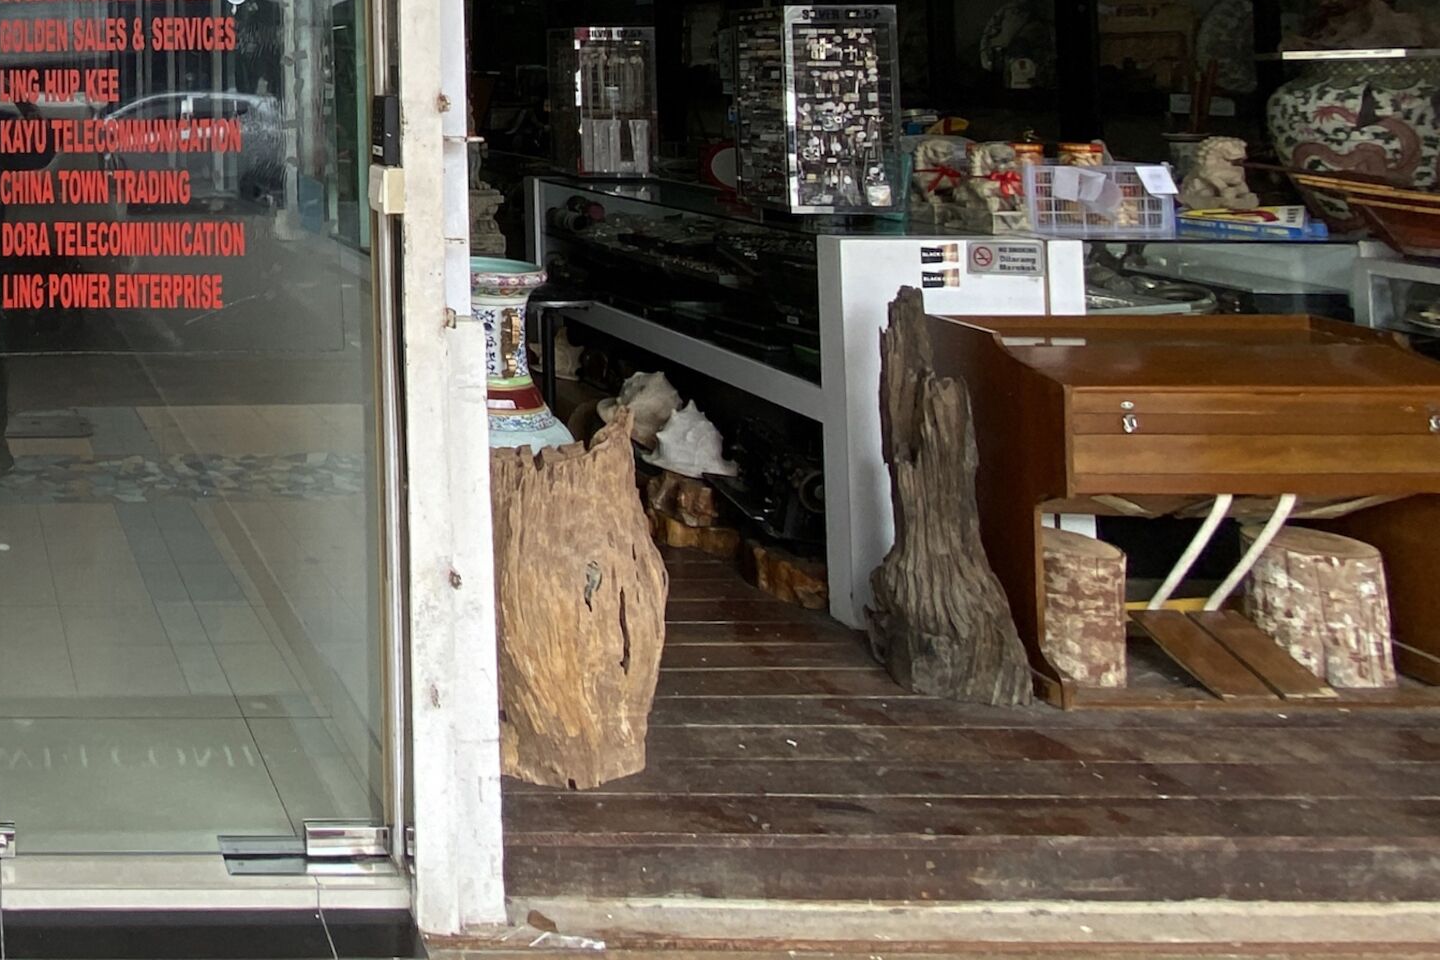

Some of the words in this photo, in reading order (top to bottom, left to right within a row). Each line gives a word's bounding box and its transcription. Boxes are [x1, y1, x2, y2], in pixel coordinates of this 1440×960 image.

[73, 18, 127, 51] SALES
[132, 18, 145, 51] &
[151, 17, 236, 51] SERVICES
[0, 70, 39, 102] LING
[44, 69, 80, 102] HUP
[85, 68, 119, 102] KEE
[0, 120, 47, 153] KAYU
[51, 119, 241, 152] TELECOMMUNICATION
[0, 171, 54, 204] CHINA
[59, 170, 109, 203] TOWN
[113, 170, 191, 204] TRADING
[2, 222, 50, 257] DORA
[54, 221, 245, 257] TELECOMMUNICATION
[1000, 255, 1036, 264] Dilarang
[3, 274, 45, 309] LING
[48, 273, 110, 309] POWER
[115, 273, 223, 309] ENTERPRISE
